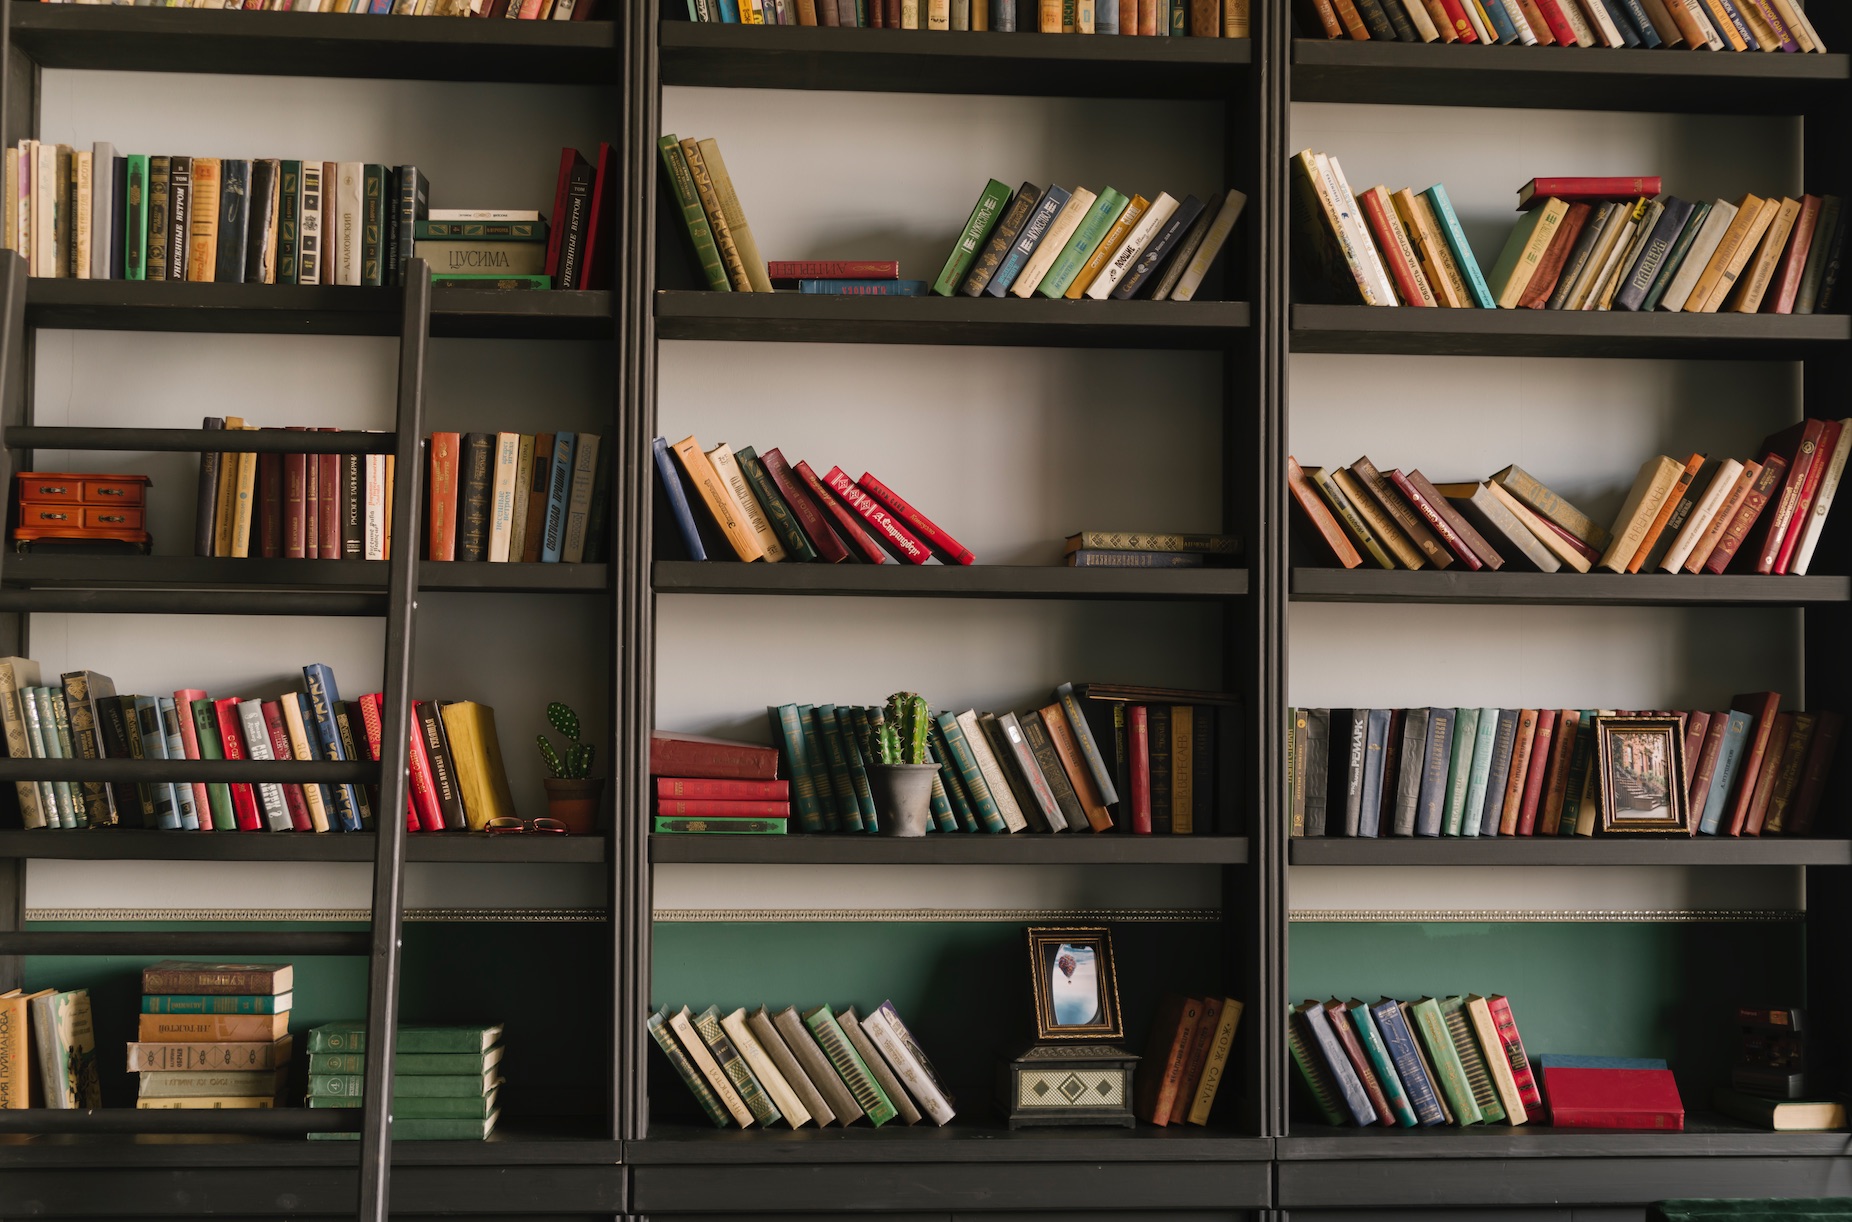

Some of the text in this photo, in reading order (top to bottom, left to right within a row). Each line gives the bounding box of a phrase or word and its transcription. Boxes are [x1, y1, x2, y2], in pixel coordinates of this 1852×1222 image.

[1773, 19, 1783, 32] ЧТО
[79, 159, 89, 189] ВЫСОТА
[1323, 172, 1341, 203] Почемучка
[171, 186, 185, 278] УНЕСЕННЫЕ ВЕТРОМ
[569, 197, 581, 231] ВЕТРОМ
[968, 206, 992, 239] МУЖЕСТВО
[1025, 209, 1052, 241] МУЖЕСТВО
[1081, 210, 1106, 242] МУЖЕСТВО
[341, 212, 352, 270] А.ЧАКОВСКИЙ
[1113, 243, 1136, 269] ПОЮЩИЕ
[1390, 219, 1411, 258] ОСТРОВАХ
[1531, 222, 1554, 252] МУЖЕСТВО
[449, 250, 510, 269] ЦУСИМА
[562, 232, 577, 288] УНЕСЕННЫЕ
[1407, 256, 1416, 268] НА
[1630, 236, 1669, 290] МАСТЕРА
[1412, 268, 1431, 301] ОБЛАСТЬ
[771, 460, 816, 524] БЕЛОВ ВАСИЛИЙ
[1791, 472, 1805, 494] СЛОВАРЬ
[501, 490, 512, 521] ветром
[701, 477, 738, 529] Экстренный
[727, 474, 768, 534] ГРАФ МОНТЕ-КРИСТО
[872, 485, 937, 536] ЖОРЖ САНД Консуэло
[1352, 487, 1400, 542] В.ВЕРЕСАЕВ
[1418, 501, 1455, 543] ЖОРЖ САНД
[1627, 484, 1666, 542] В.ВЕРЕСАЕВ
[544, 503, 561, 551] СВЯТОСЛАВ
[869, 508, 924, 559] А.Стриндберг
[246, 720, 258, 742] Драйзер
[253, 720, 264, 740] Теодор
[1347, 718, 1366, 767] РЕМАРК
[424, 716, 452, 800] ПАНАС МИРНЫЙ ГУЛЯЩАЯ
[1176, 734, 1188, 798] В.ВЕРЕСАЕВ
[198, 974, 244, 986] КУПРИН
[0, 1009, 9, 1109] АРИЯ ПУЙМАНОВА
[1201, 1025, 1232, 1100] ЖОРЖ САНД
[333, 1082, 340, 1091] 4
